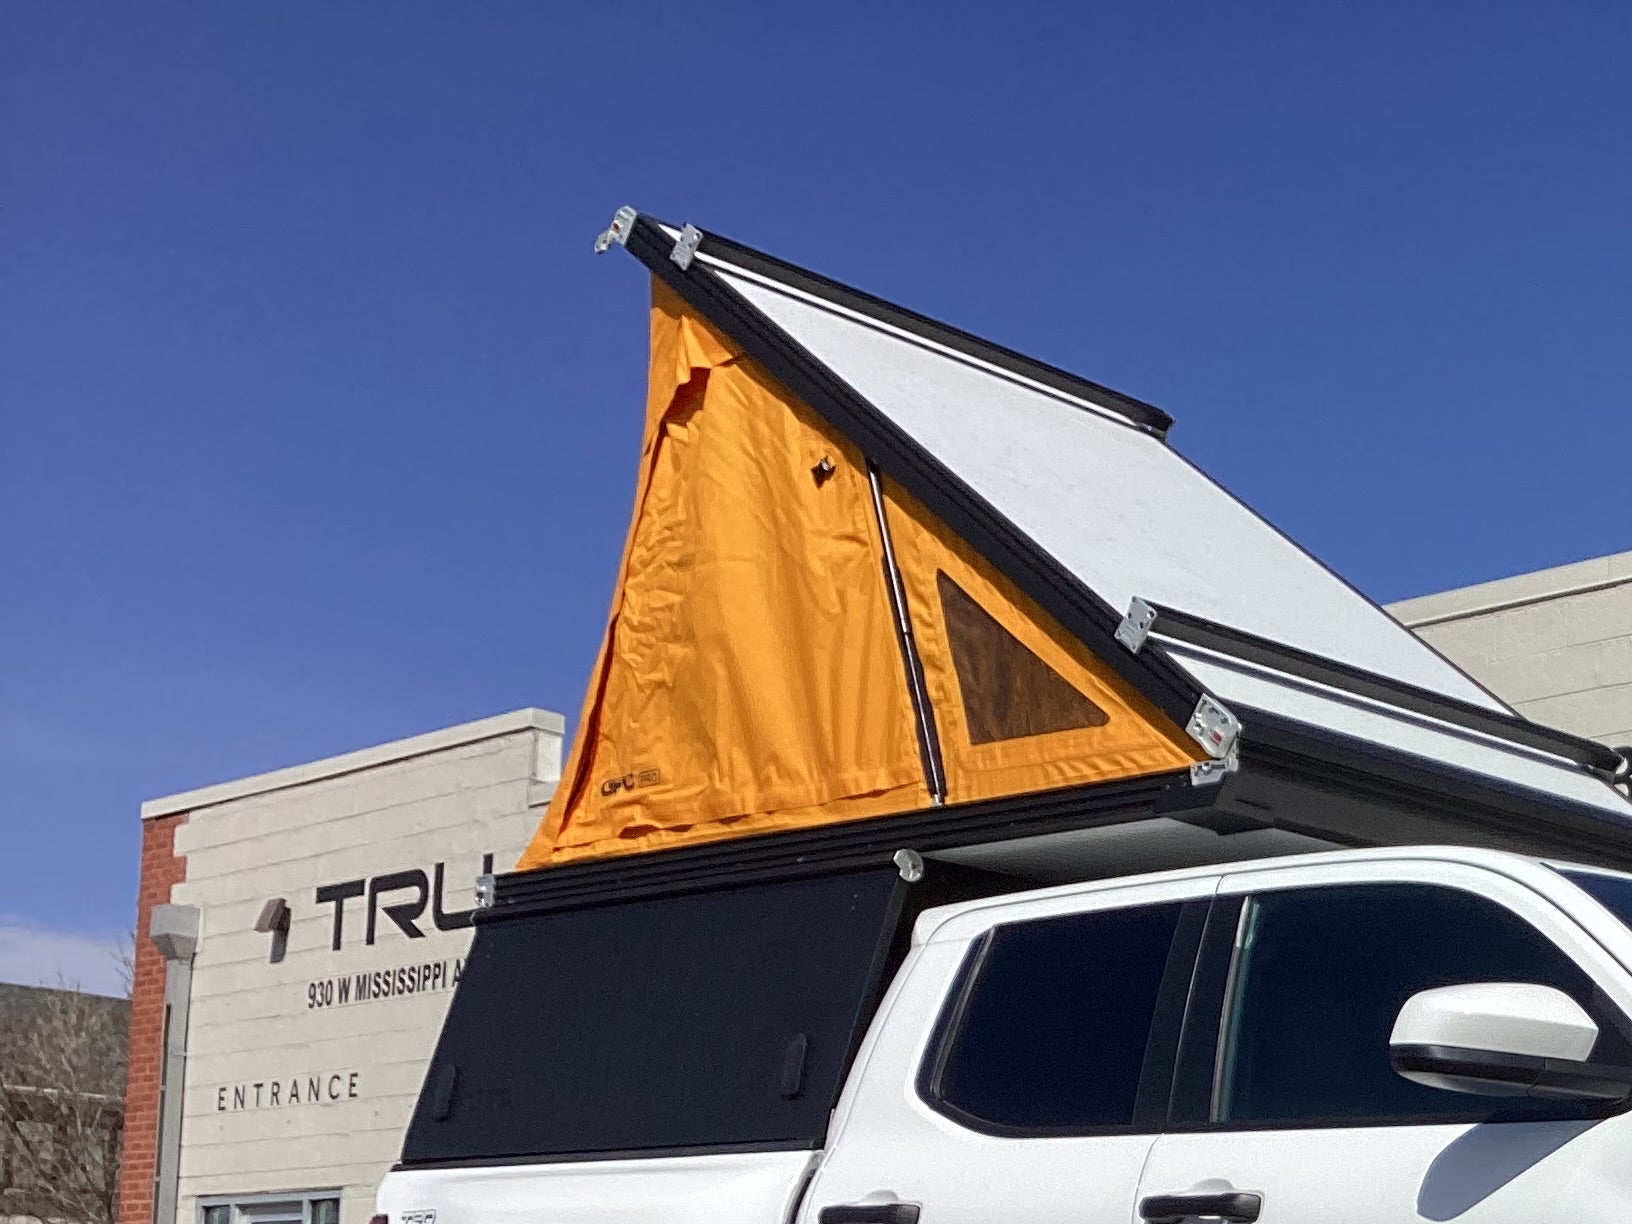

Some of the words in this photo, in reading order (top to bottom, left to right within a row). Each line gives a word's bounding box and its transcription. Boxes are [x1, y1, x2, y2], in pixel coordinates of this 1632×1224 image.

[316, 853, 494, 951] TRU
[308, 979, 333, 1009] 930
[337, 976, 351, 1004] W
[354, 960, 447, 1001] MISSISSIPPI
[217, 1072, 359, 1111] ENTRANCE
